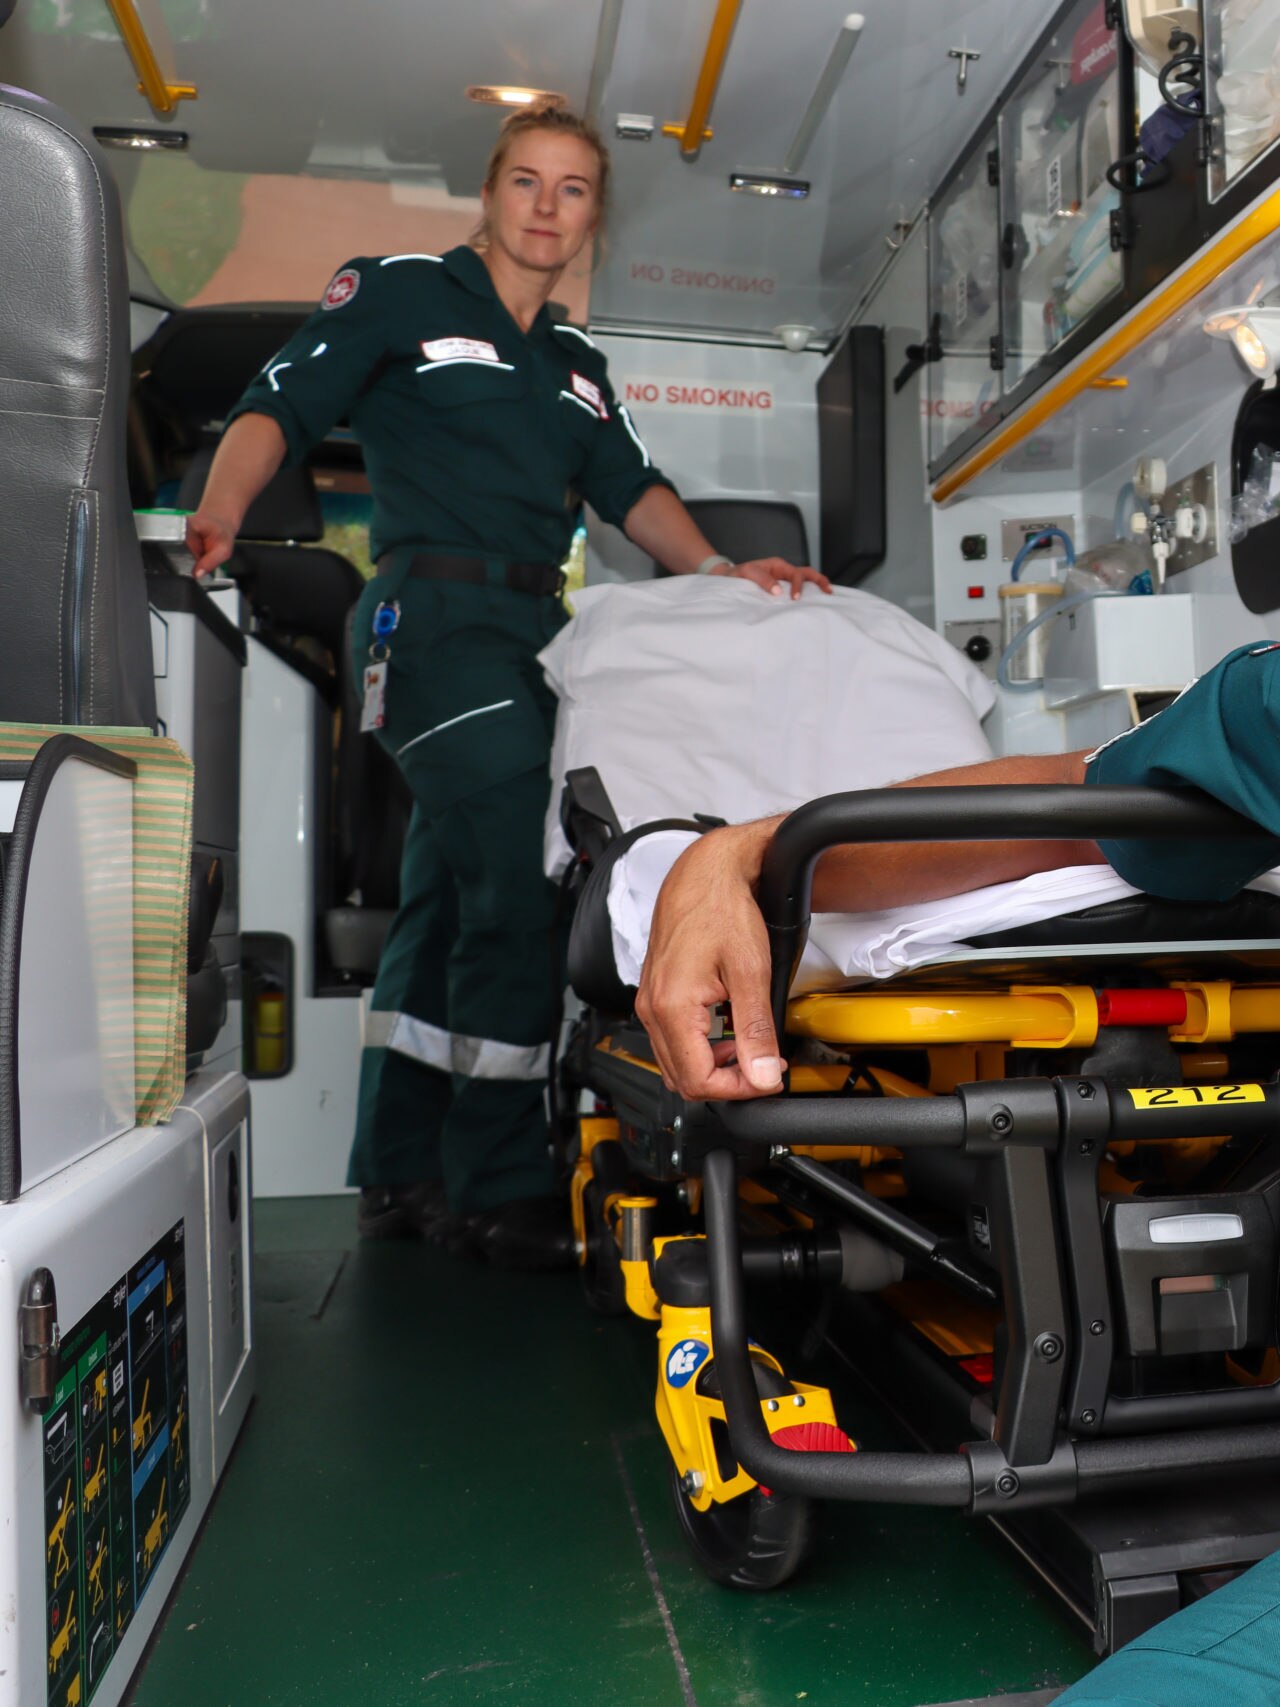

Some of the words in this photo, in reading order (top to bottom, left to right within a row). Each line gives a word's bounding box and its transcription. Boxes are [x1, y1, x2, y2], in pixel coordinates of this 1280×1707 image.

[625, 383, 659, 402] NO
[666, 385, 772, 409] SMOKING
[1146, 1085, 1246, 1106] 212
